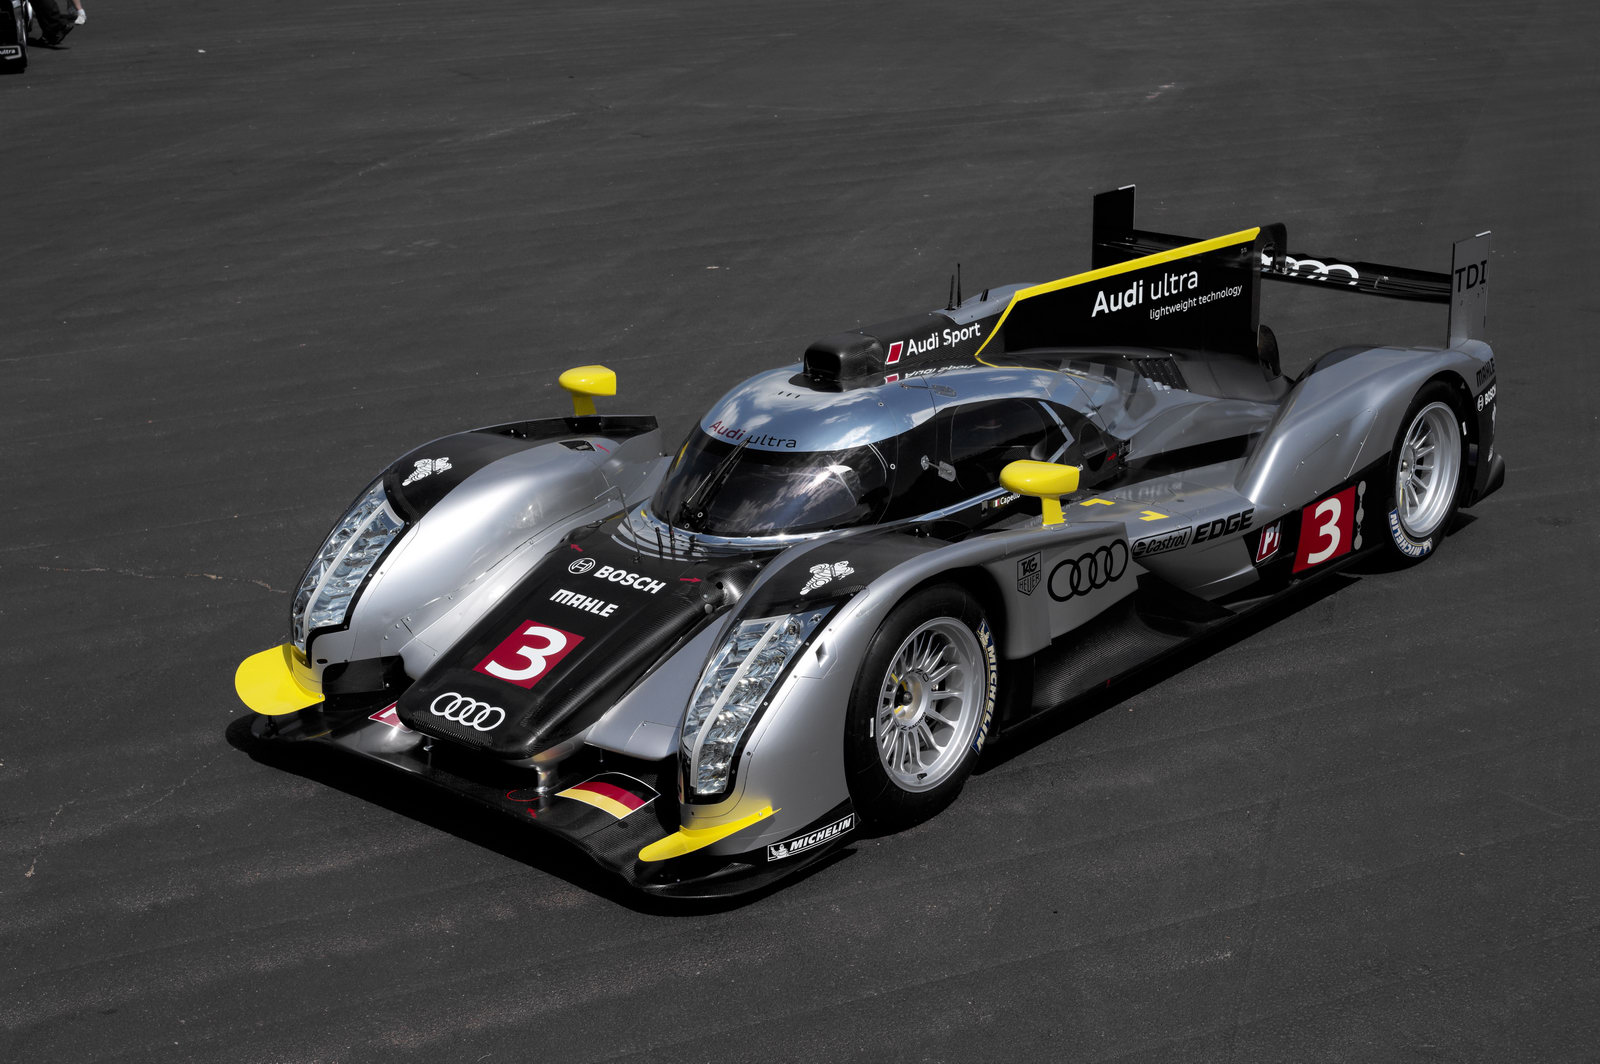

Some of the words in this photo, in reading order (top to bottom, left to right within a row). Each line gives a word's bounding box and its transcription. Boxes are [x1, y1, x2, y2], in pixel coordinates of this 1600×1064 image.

[1455, 260, 1487, 293] TDI
[1091, 279, 1144, 317] Audi
[1151, 271, 1198, 300] ultra
[1150, 297, 1197, 320] lightweight
[1199, 285, 1243, 305] technology
[906, 332, 940, 357] Audi
[942, 322, 981, 348] Sport
[709, 420, 746, 441] Audi
[746, 434, 797, 449] ultra
[1145, 531, 1187, 554] Castrol
[1191, 508, 1254, 545] EDGE
[1262, 521, 1281, 555] P1
[1306, 496, 1342, 565] 3
[1389, 513, 1423, 556] MICHELIN
[593, 565, 667, 595] BOSCH
[1020, 573, 1040, 593] HEUER
[1021, 557, 1038, 576] TAG
[549, 588, 619, 618] MAHLE
[484, 625, 568, 681] 3
[975, 644, 998, 750] MICHELIN
[789, 817, 852, 851] MICHELIN
